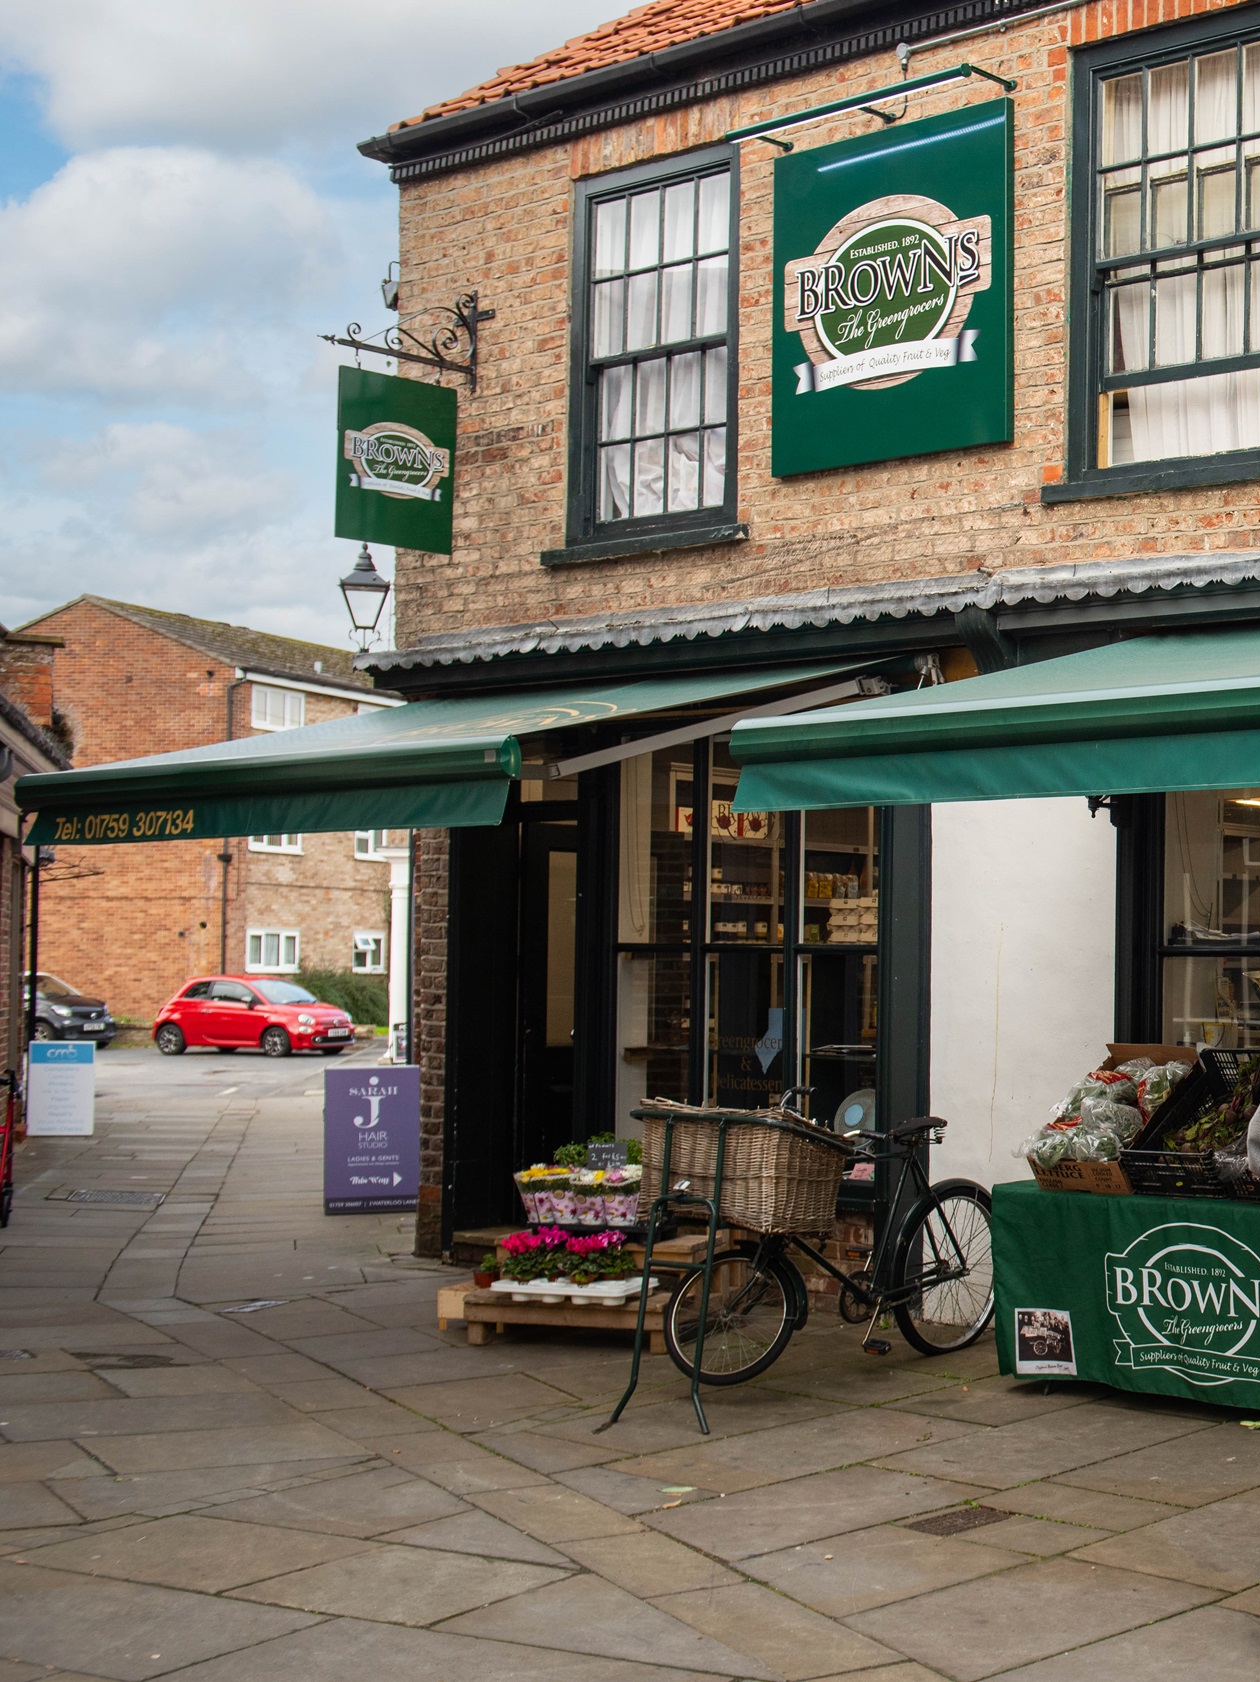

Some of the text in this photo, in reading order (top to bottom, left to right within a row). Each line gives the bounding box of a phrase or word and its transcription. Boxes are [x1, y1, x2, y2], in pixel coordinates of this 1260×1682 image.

[850, 234, 920, 259] ESTABLISHED. 1892
[795, 229, 980, 320] BROWNS
[834, 294, 945, 349] The Greengrocers
[819, 347, 951, 382] Suppliers of Quality Fruit & Veg
[351, 435, 444, 472] BROWNS
[372, 462, 427, 481] The Greengrocers
[54, 809, 195, 840] Tel: 01759 307134
[740, 1056, 752, 1072] &
[349, 1086, 398, 1096] SARAH
[358, 1141, 387, 1149] STUDIO
[359, 1131, 388, 1141] HAIR
[369, 1175, 390, 1185] Way
[1034, 1167, 1085, 1179] LETTUCE
[372, 1199, 402, 1207] WATERLOO
[1164, 1261, 1226, 1278] ESTABLISHED. 1892
[1162, 1315, 1243, 1345] The Greengrocers
[1140, 1350, 1178, 1362] Suppliers
[1184, 1354, 1211, 1370] Quality
[1212, 1358, 1232, 1371] Fruit
[1232, 1362, 1240, 1372] &
[1242, 1364, 1260, 1376] Veg
